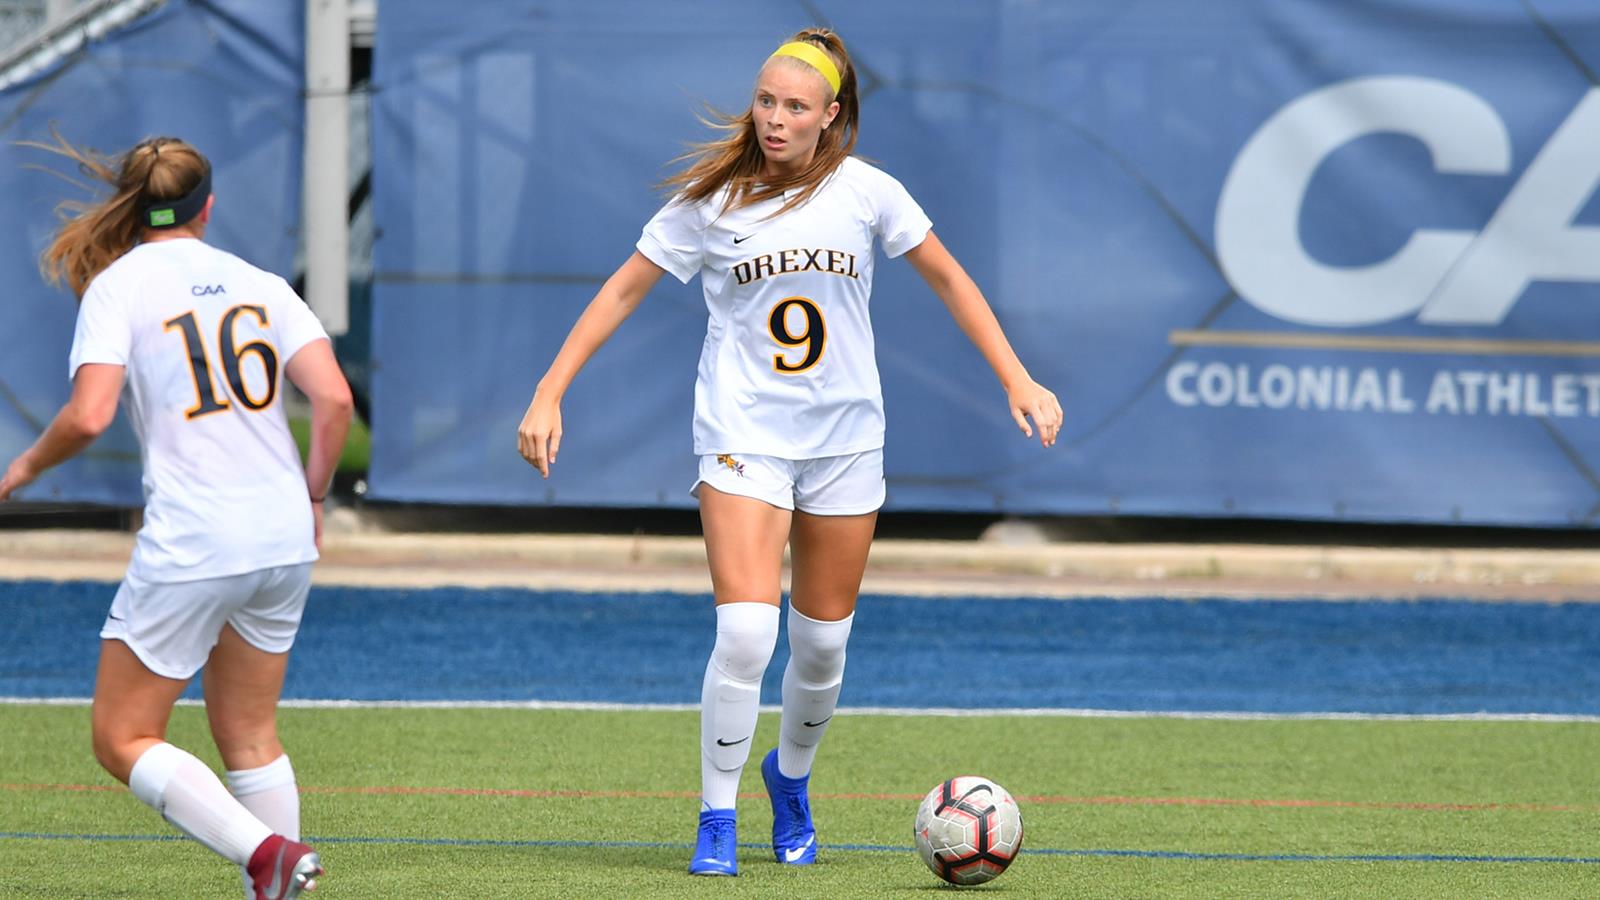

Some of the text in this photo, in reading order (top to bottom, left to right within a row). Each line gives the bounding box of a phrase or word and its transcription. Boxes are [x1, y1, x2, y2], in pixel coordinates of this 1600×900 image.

[191, 284, 226, 297] CAA
[732, 248, 860, 286] DREXEL
[163, 303, 280, 421] 16
[767, 296, 827, 375] 9
[1165, 360, 1600, 418] COLONIAL ATHLET
